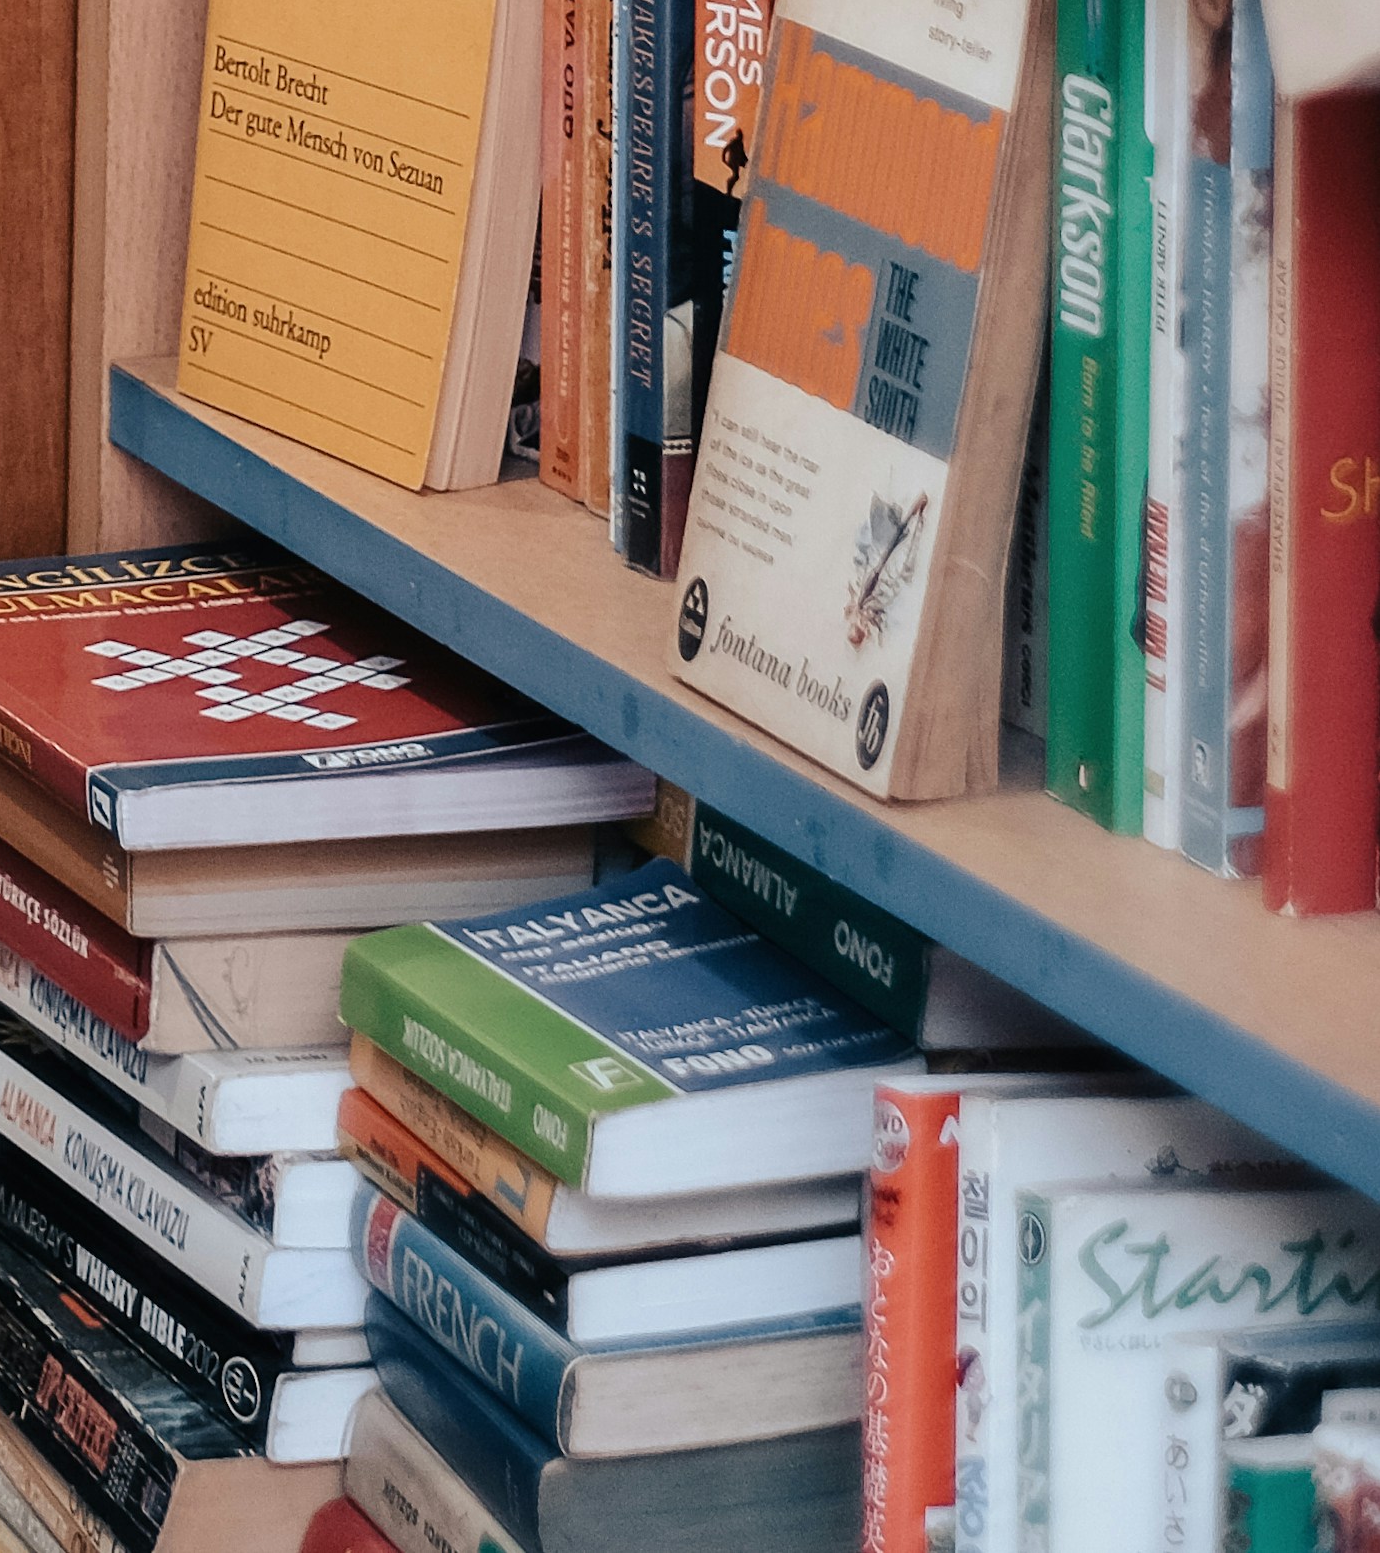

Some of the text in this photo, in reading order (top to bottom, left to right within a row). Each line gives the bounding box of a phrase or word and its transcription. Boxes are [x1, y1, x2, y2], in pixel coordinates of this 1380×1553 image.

[214, 35, 330, 108] Bertolt Brecht
[563, 63, 575, 140] QUO
[210, 92, 444, 195] Der gute Mensch von Sezuan
[1060, 71, 1117, 339] Clarkson
[194, 283, 331, 359] edition suhrkamp
[629, 252, 654, 389] SECRET
[886, 260, 919, 323] THE
[1273, 258, 1288, 338] CAESAR
[189, 326, 214, 358] SV
[876, 316, 930, 390] WHITE
[866, 375, 919, 440] SOUTH
[1081, 357, 1099, 473] Born to be
[709, 616, 852, 722] fontana books
[698, 821, 798, 918] ALMANCA
[43, 903, 90, 959] SÖZLÜK
[463, 883, 700, 951] İTALYANCA
[834, 919, 895, 989] FONO
[661, 1044, 777, 1077] FONO
[533, 1103, 568, 1151] FONO
[0, 1081, 190, 1251] ALMANCA KONUŞMA KILAVUZU
[75, 1242, 137, 1318] WHISKY
[141, 1294, 188, 1359] BIBLE
[186, 1332, 219, 1385] 2012
[401, 1256, 522, 1404] FRENCH
